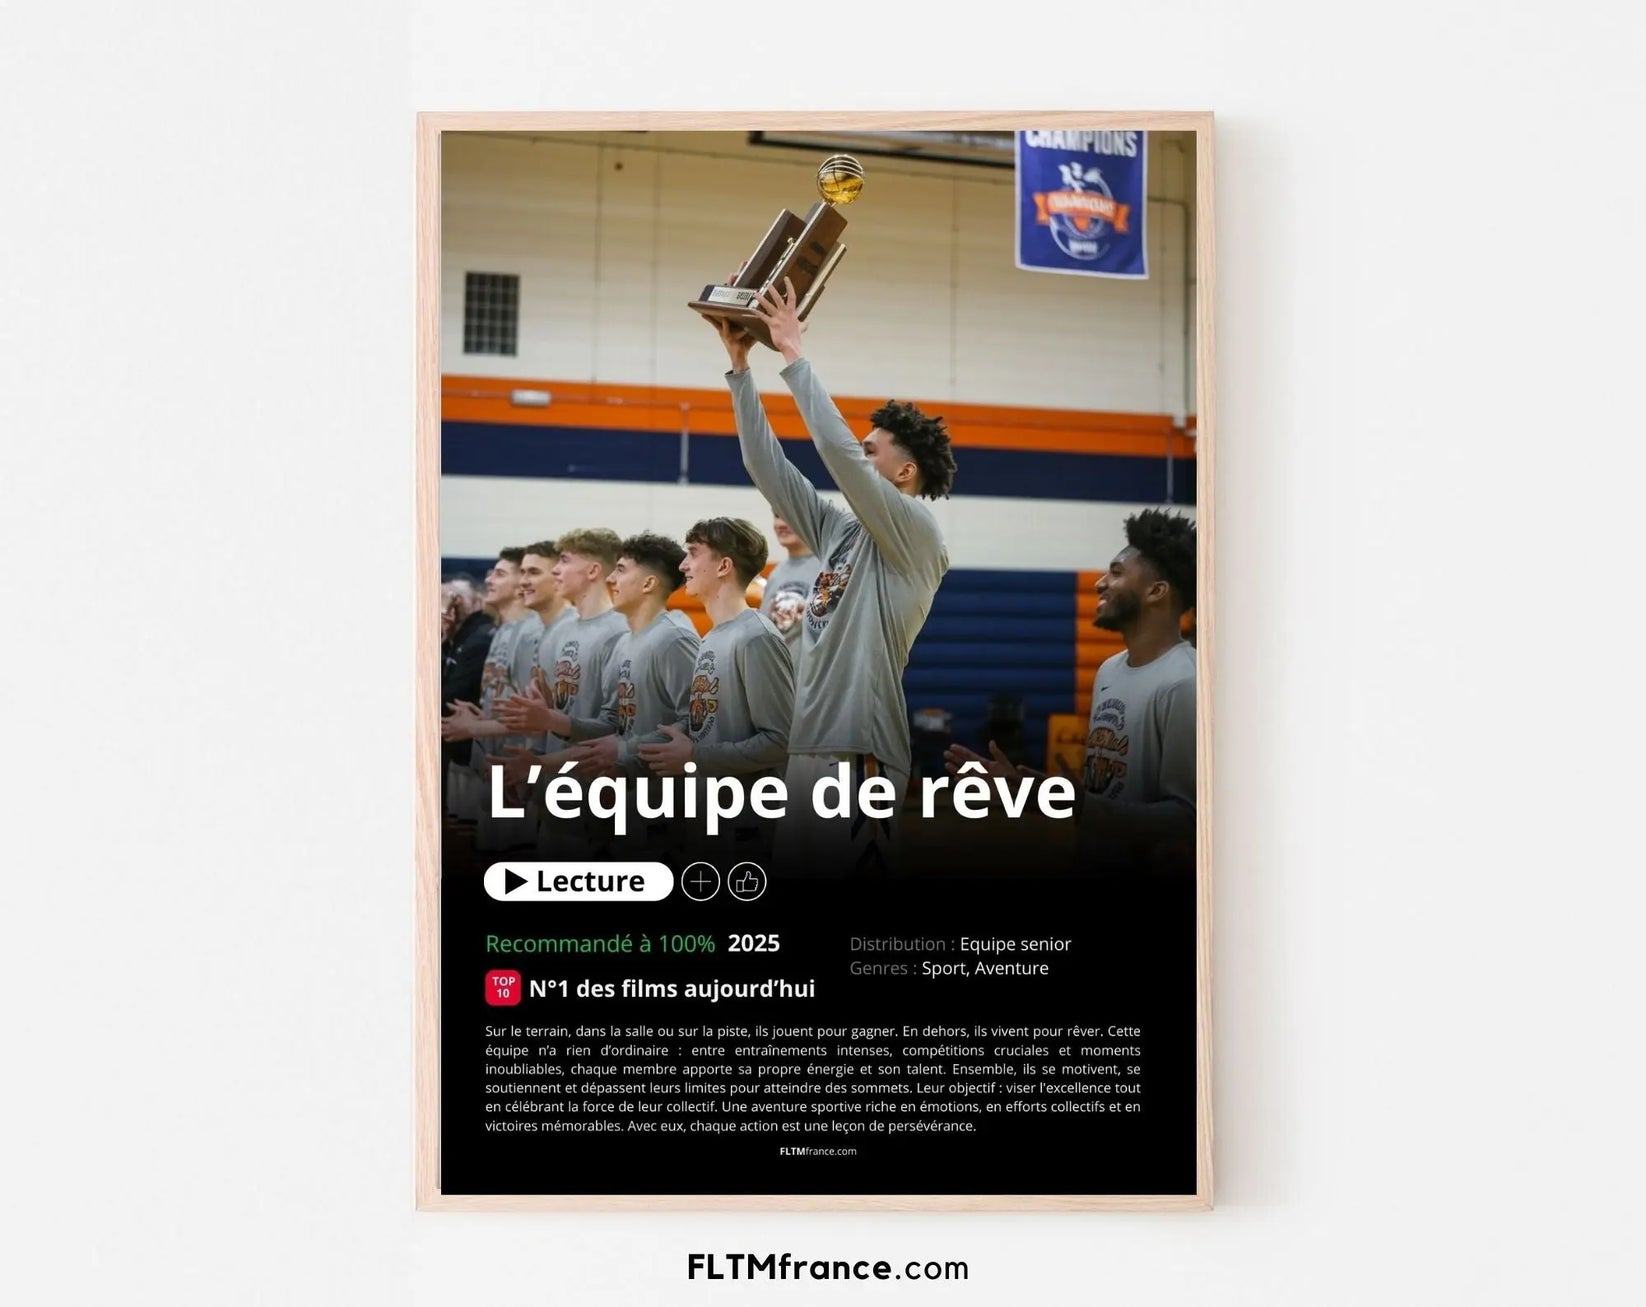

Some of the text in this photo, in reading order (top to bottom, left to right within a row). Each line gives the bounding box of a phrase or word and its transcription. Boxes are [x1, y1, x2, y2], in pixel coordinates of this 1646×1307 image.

[1025, 131, 1138, 157] CHAMPIONS
[491, 761, 1075, 836] L’équipe de rêve
[538, 870, 645, 892] Lecture
[487, 933, 780, 953] Recommandé à 100% 2025
[850, 936, 946, 951] Distribution
[960, 936, 1016, 956] Equipe
[1020, 936, 1073, 952] senior
[850, 961, 908, 975] Genres
[921, 960, 970, 980] Sport,
[974, 960, 1050, 976] Aventure
[492, 976, 516, 986] TOP
[496, 988, 510, 998] 10
[530, 978, 815, 1003] N°1 des films aujourd’hui
[485, 1024, 1141, 1040] Sur le terrain, dans la salle ou sur la piste, ils jouent pour gagner. En dehors, ils vivent pour rêver. Cette
[485, 1044, 529, 1060] équipe
[538, 1044, 557, 1057] n’a
[566, 1044, 591, 1057] rien
[600, 1044, 669, 1057] d’ordinaire
[691, 1045, 726, 1057] entre
[734, 1044, 828, 1057] entraînements
[837, 1044, 893, 1058] intenses,
[902, 1044, 985, 1059] compétitions
[993, 1044, 1049, 1057] cruciales
[1058, 1046, 1072, 1057] et
[1080, 1046, 1141, 1057] moments
[485, 1062, 1141, 1078] inoubliables, chaque membre apporte sa propre énergie et son talent. Ensemble, ils se motivent, se
[485, 1082, 562, 1094] soutiennent
[564, 1083, 578, 1094] et
[580, 1081, 646, 1097] dépassent
[649, 1081, 681, 1094] leurs
[684, 1081, 726, 1094] limites
[730, 1084, 761, 1097] pour
[763, 1081, 822, 1094] atteindre
[825, 1081, 848, 1094] des
[851, 1083, 913, 1094] sommets.
[917, 1082, 946, 1094] Leur
[948, 1081, 996, 1097] objectif
[1005, 1082, 1037, 1094] viser
[1039, 1081, 1112, 1094] l'excellence
[1114, 1083, 1141, 1094] tout
[485, 1100, 1141, 1116] en célébrant la force de leur collectif. Une aventure sportive riche en émotions, en efforts collectifs et en
[485, 1119, 977, 1135] victoires mémorables. Avec eux, chaque action est une leçon de persévérance.
[779, 1146, 857, 1156] FLTMfrance.com
